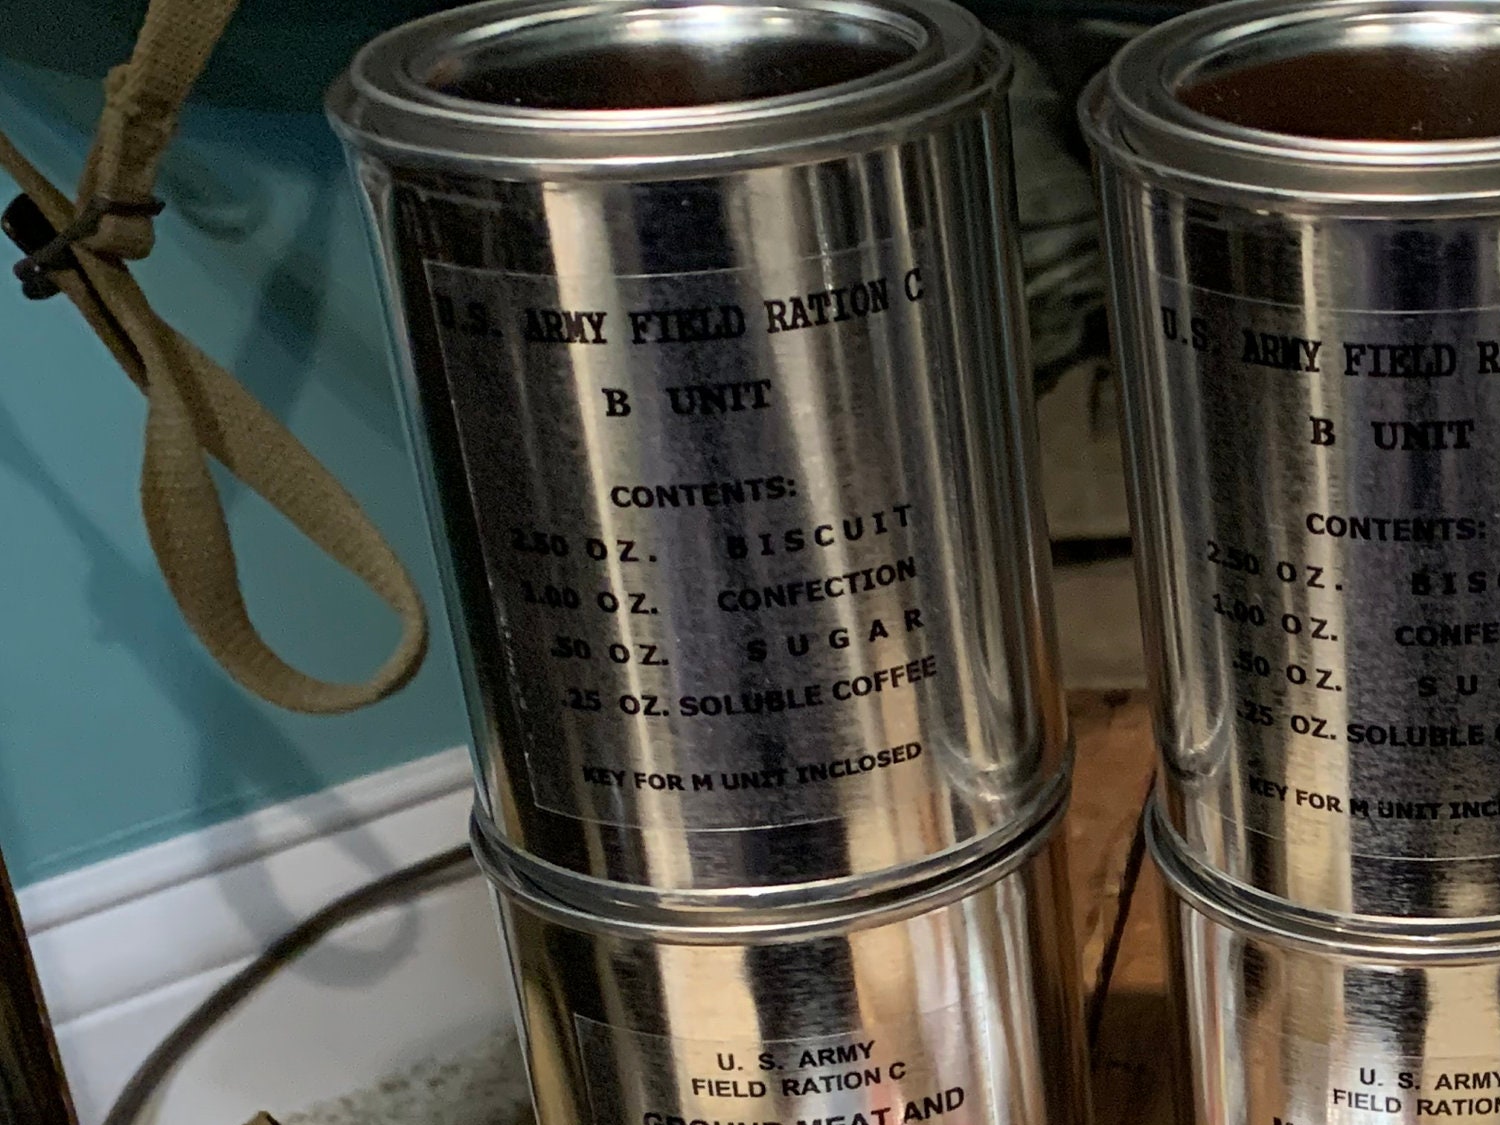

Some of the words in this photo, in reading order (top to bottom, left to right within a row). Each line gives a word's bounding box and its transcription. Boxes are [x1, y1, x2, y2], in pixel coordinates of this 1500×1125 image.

[524, 309, 606, 344] ARMY
[630, 306, 746, 344] FIELD
[764, 285, 890, 334] RATION
[905, 268, 923, 301] C
[1242, 330, 1321, 373] ARMY
[1344, 343, 1457, 377] FIELD
[603, 388, 632, 417] B
[666, 379, 771, 415] UNIT
[1310, 416, 1336, 446] B
[1372, 420, 1473, 450] UNIT
[611, 476, 797, 508] CONTENTS:
[728, 505, 912, 560] BISCUIT
[1306, 513, 1486, 542] CONTENTS:
[717, 557, 917, 614] CONFECTION
[747, 609, 924, 662] SUGAR
[680, 685, 820, 718] SOLUBLE
[832, 656, 936, 700] COFFEE
[1347, 724, 1484, 747] SOLUBLE
[634, 772, 684, 790] FOR
[721, 769, 787, 790] UNIT
[798, 742, 922, 784] INCLOSED
[1296, 790, 1342, 813] FOR
[1378, 801, 1441, 820] UNIT
[717, 1053, 743, 1070] U.
[759, 1053, 784, 1070] S.
[799, 1040, 875, 1068] ARMY
[692, 1078, 765, 1098] FIELD
[782, 1067, 881, 1096] RATION
[889, 1062, 906, 1080] C
[1360, 1068, 1383, 1086] U.
[1398, 1071, 1420, 1089] S.
[903, 1086, 964, 1125] AND
[1333, 1089, 1401, 1114] FIELD
